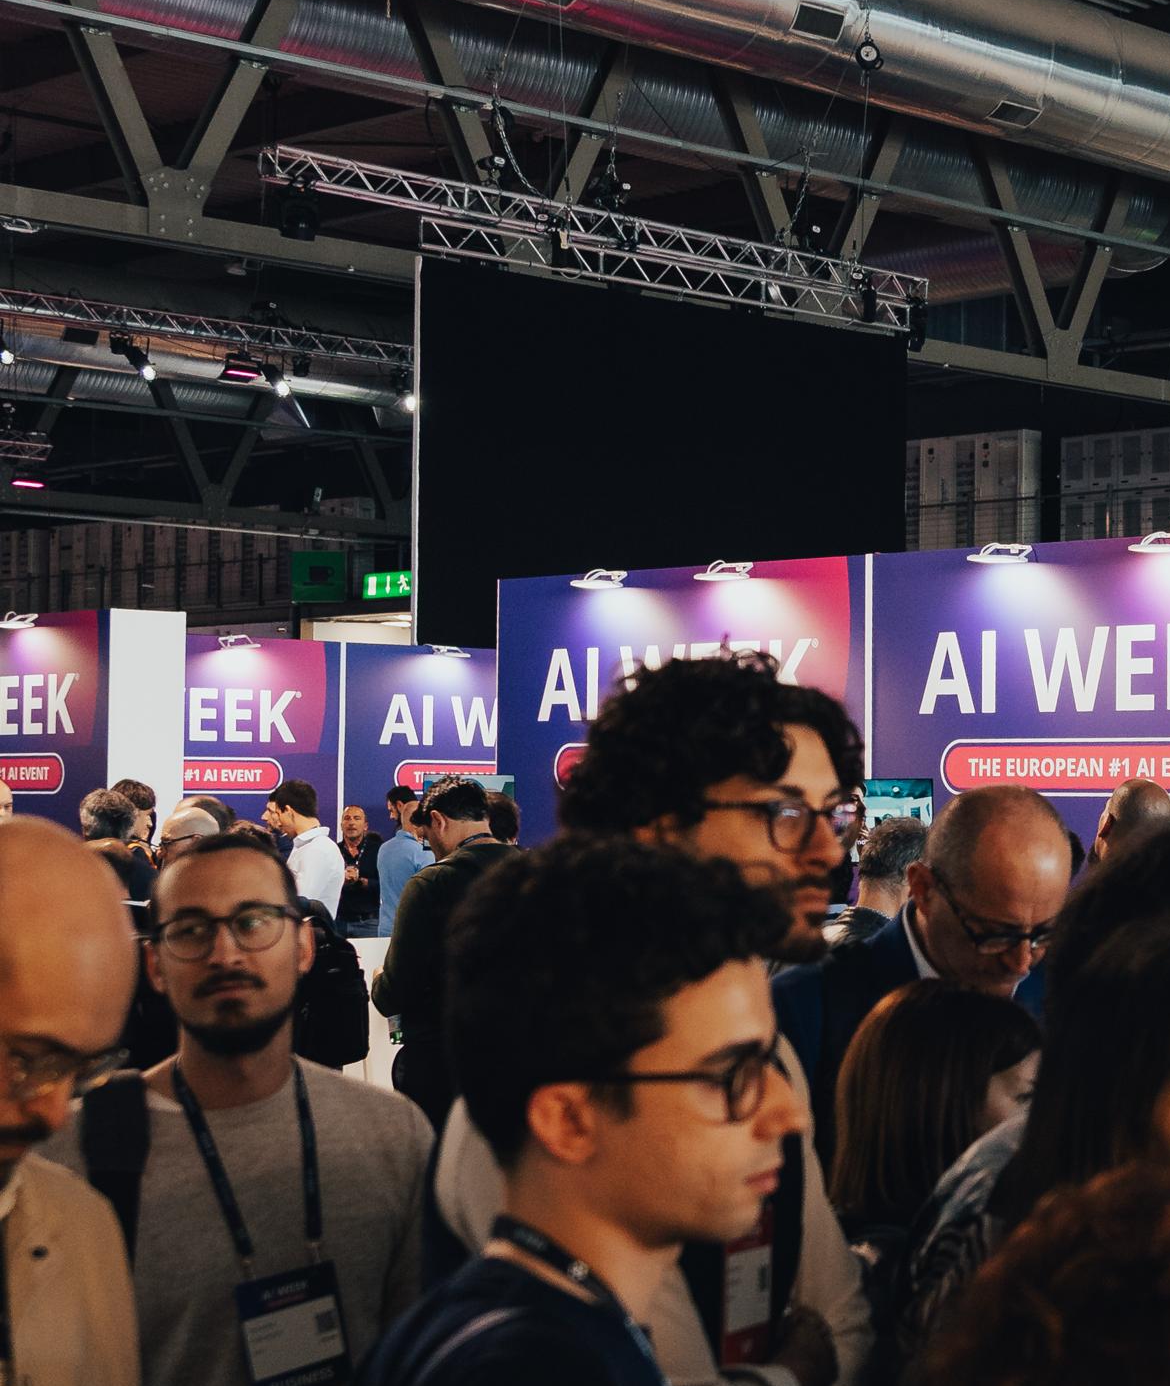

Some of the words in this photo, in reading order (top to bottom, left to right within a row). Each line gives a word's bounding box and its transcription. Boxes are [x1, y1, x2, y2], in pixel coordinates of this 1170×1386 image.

[537, 647, 599, 722] AI
[919, 630, 997, 715] AI
[184, 687, 297, 743] EEK
[379, 694, 434, 746] AI
[7, 766, 18, 781] AI
[20, 766, 50, 781] EVENT
[184, 769, 200, 782] #1
[203, 769, 218, 782] AI
[221, 769, 263, 782] EVENT
[968, 758, 1001, 777] THE
[1005, 757, 1104, 777] EUROPEAN
[1108, 757, 1131, 777] #1
[1136, 758, 1156, 778] AI
